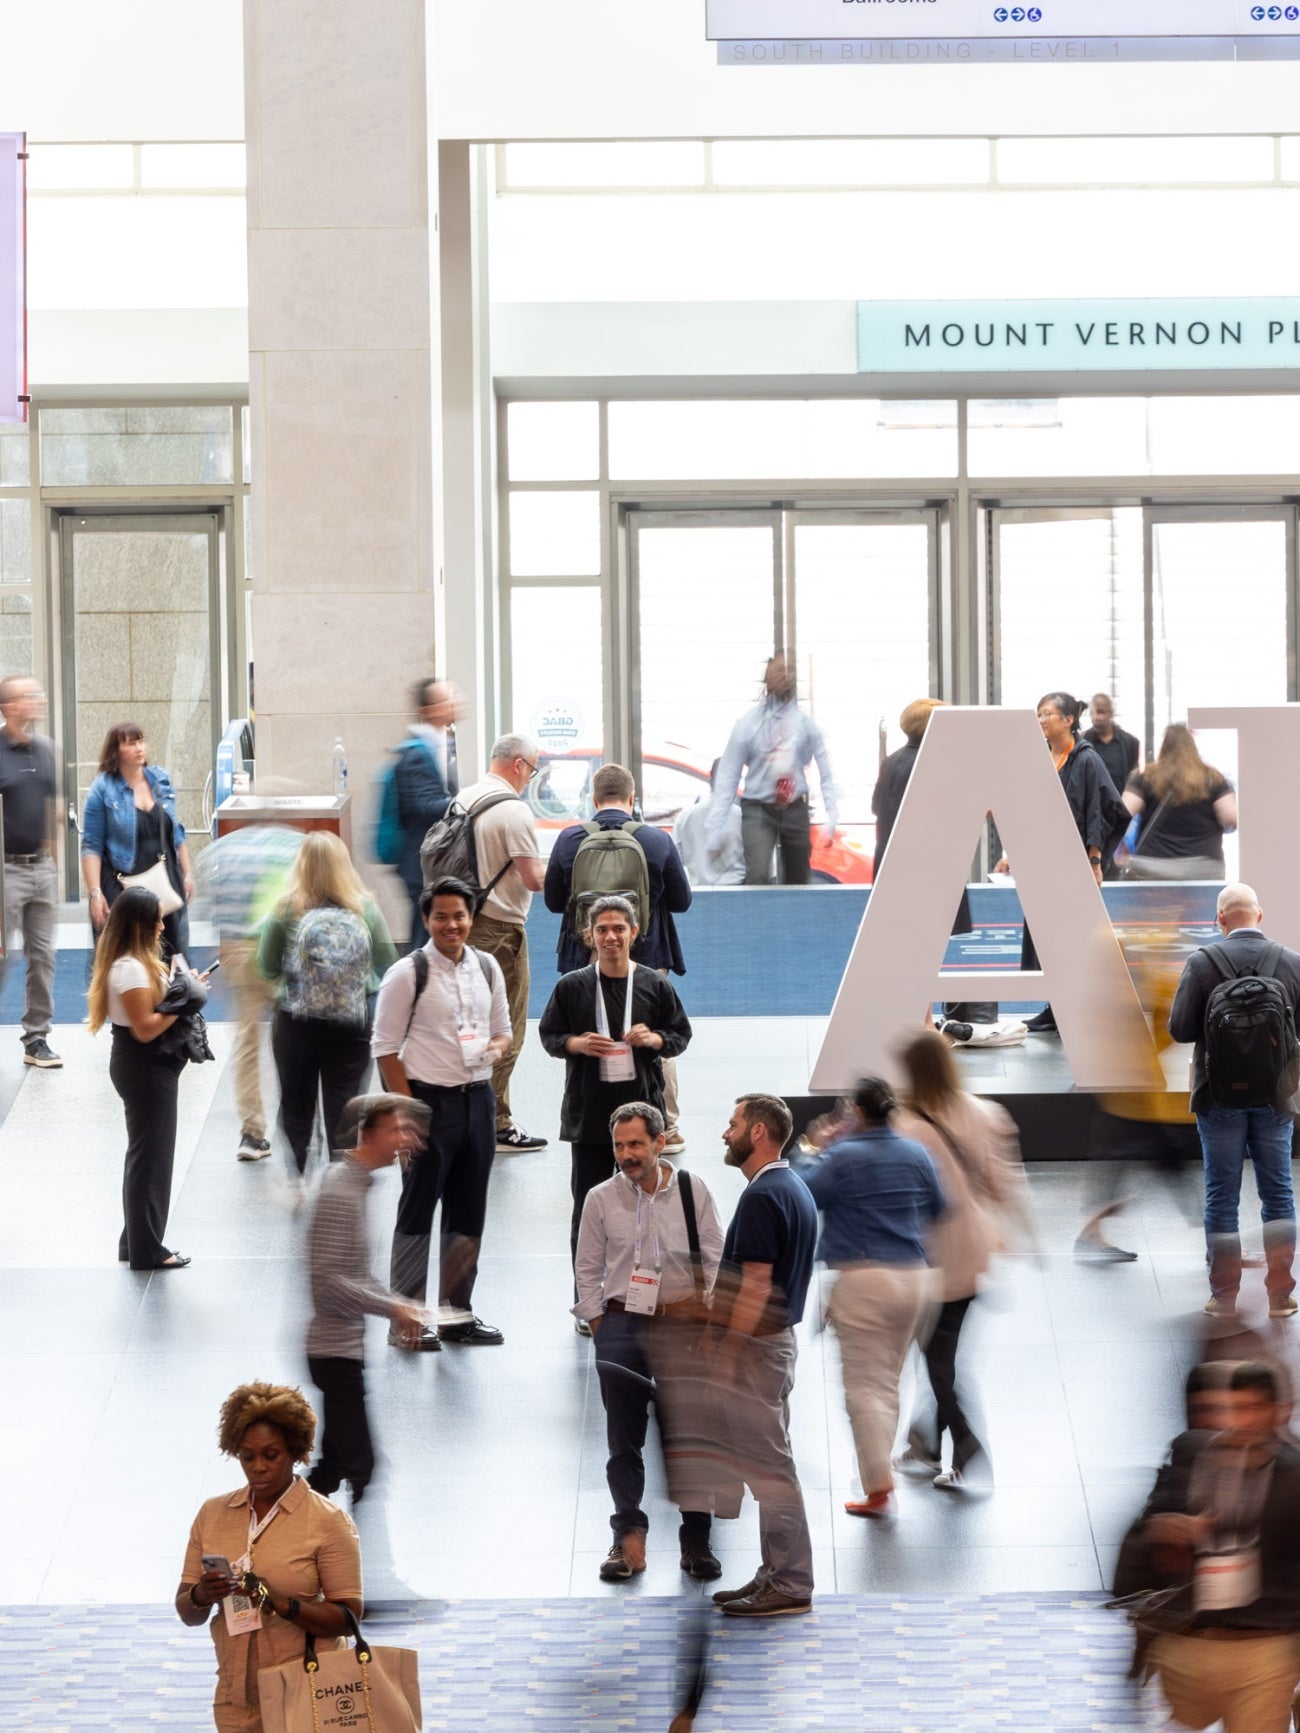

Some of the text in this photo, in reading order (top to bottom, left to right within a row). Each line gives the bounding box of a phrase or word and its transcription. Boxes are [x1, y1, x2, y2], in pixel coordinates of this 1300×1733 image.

[733, 43, 824, 61] SOUTH
[841, 42, 972, 60] BUILDING
[1013, 42, 1096, 58] LEVEL
[1112, 41, 1122, 57] 1
[904, 322, 1055, 348] MOUNT
[1075, 321, 1243, 346] VERNON
[315, 1681, 372, 1700] CHANE
[344, 1712, 369, 1721] CAMBO
